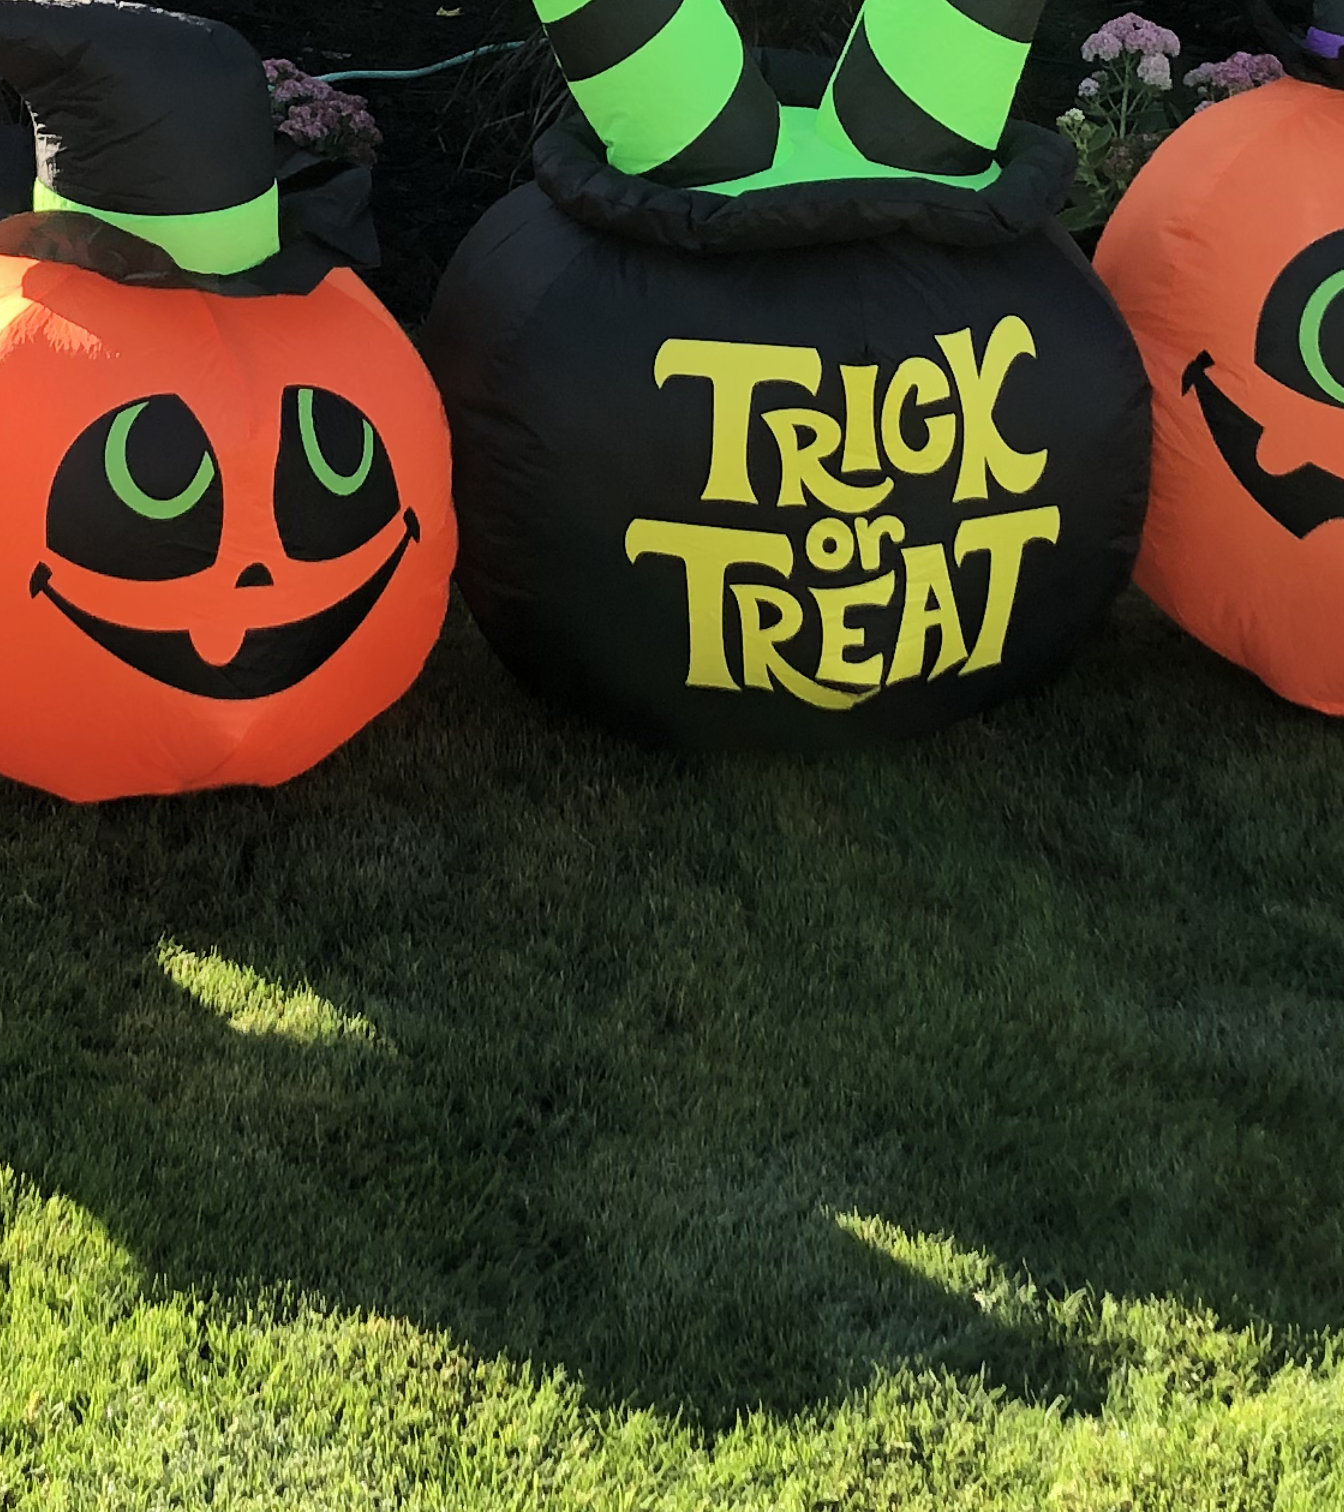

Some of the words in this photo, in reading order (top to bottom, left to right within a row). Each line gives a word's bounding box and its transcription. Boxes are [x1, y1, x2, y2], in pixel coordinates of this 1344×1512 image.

[654, 315, 1048, 514] TRICK
[624, 506, 1061, 710] TREAT
[806, 515, 906, 571] or
